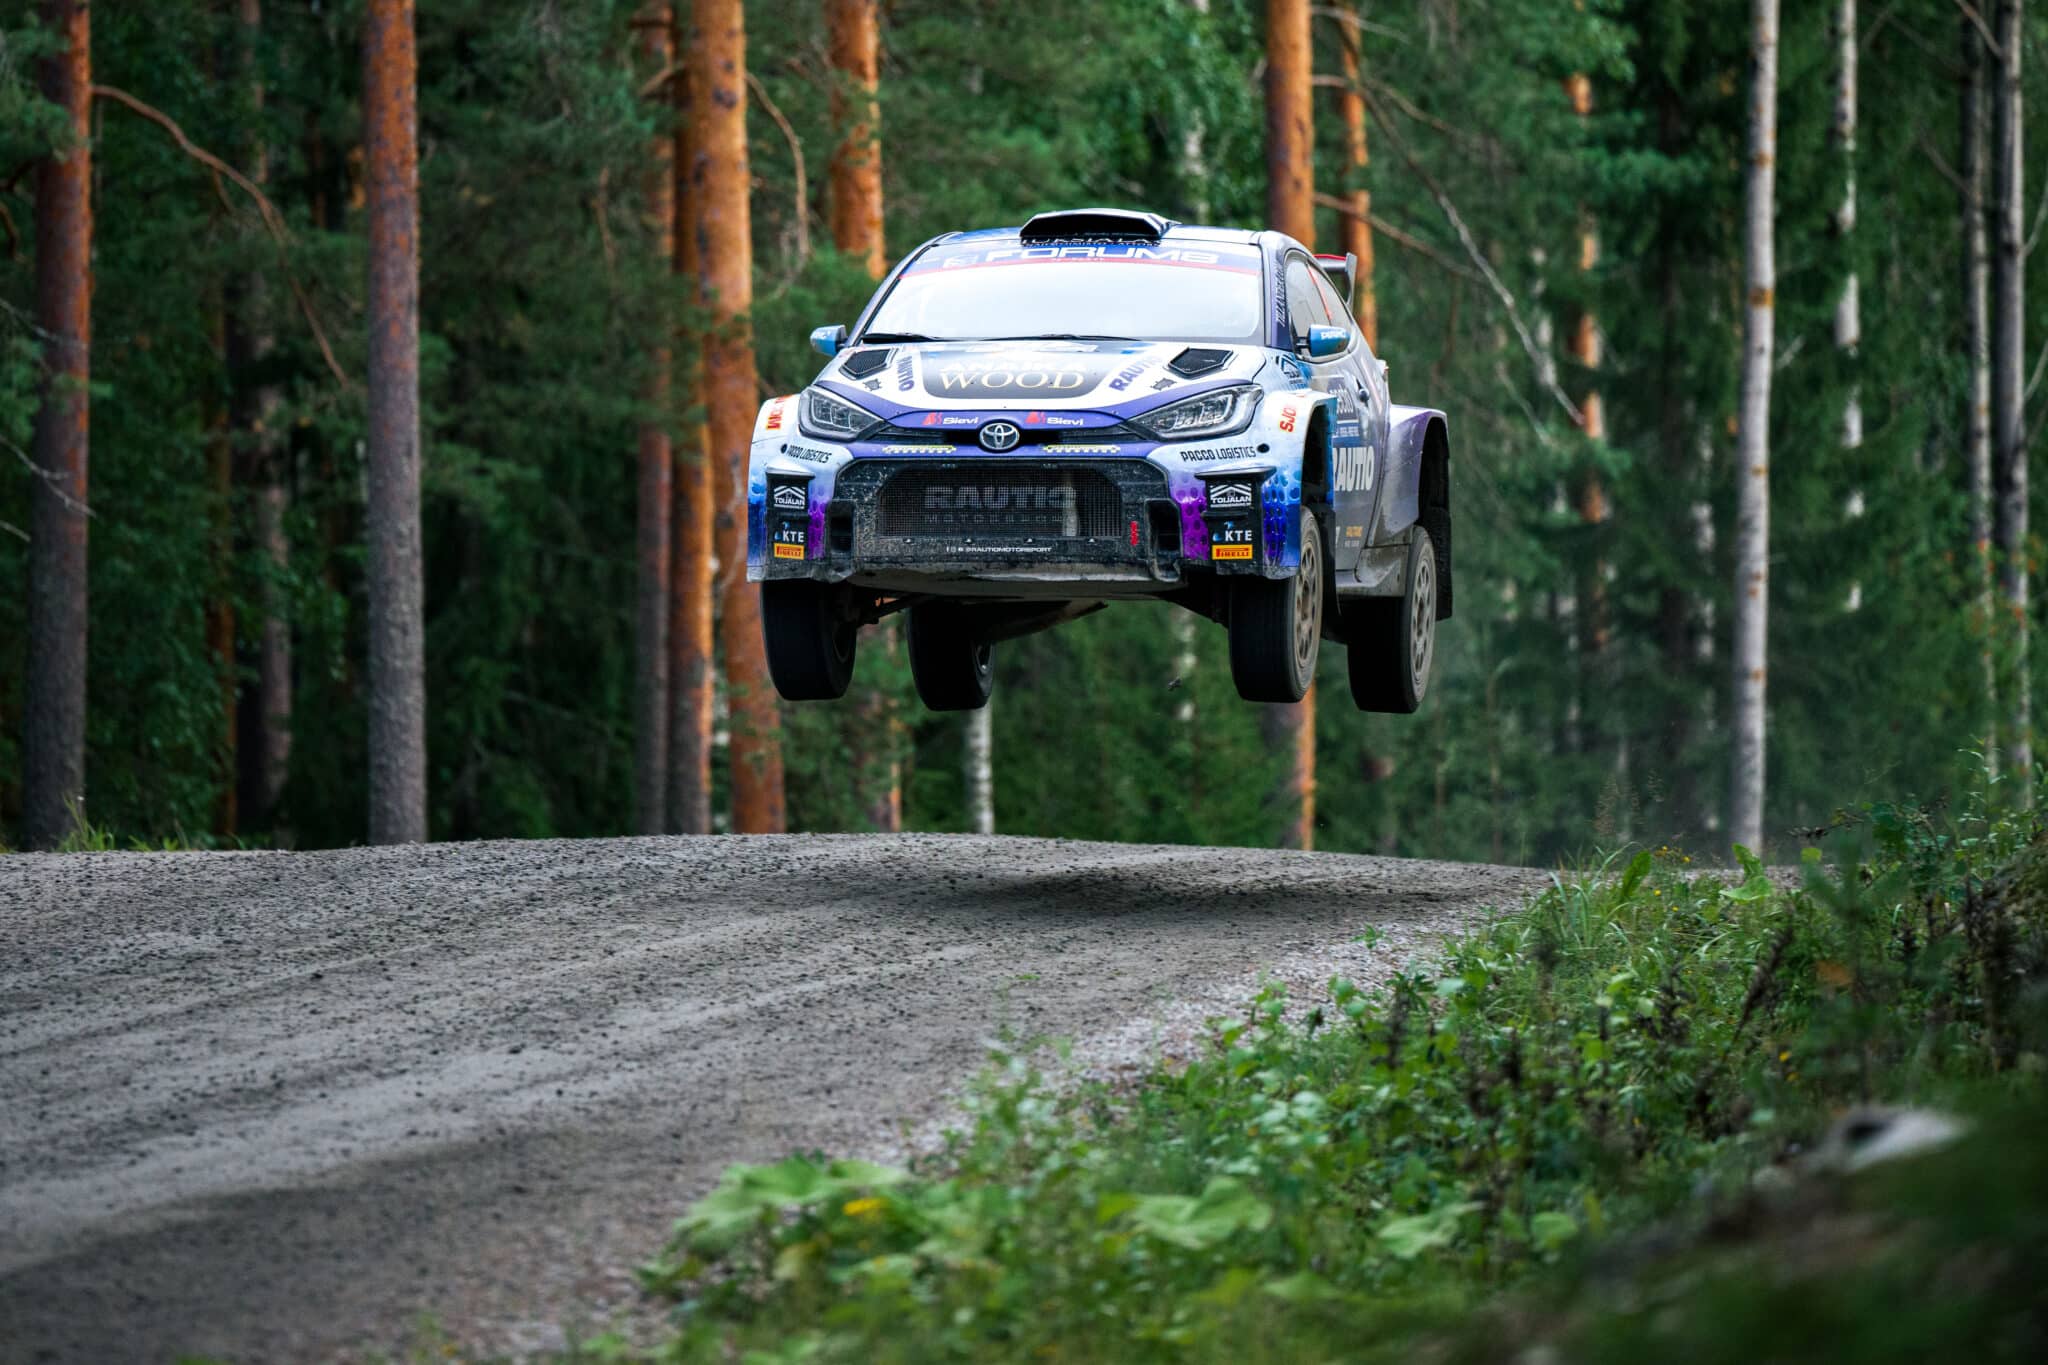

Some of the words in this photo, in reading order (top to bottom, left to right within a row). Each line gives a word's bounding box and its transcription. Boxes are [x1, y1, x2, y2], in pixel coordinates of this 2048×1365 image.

[939, 371, 1085, 390] WOOD
[1180, 449, 1216, 462] PACCO
[1215, 446, 1257, 461] LOGISTICS
[782, 530, 805, 542] KTE
[1225, 530, 1253, 542] KTE
[1215, 547, 1250, 558] PIRELLI
